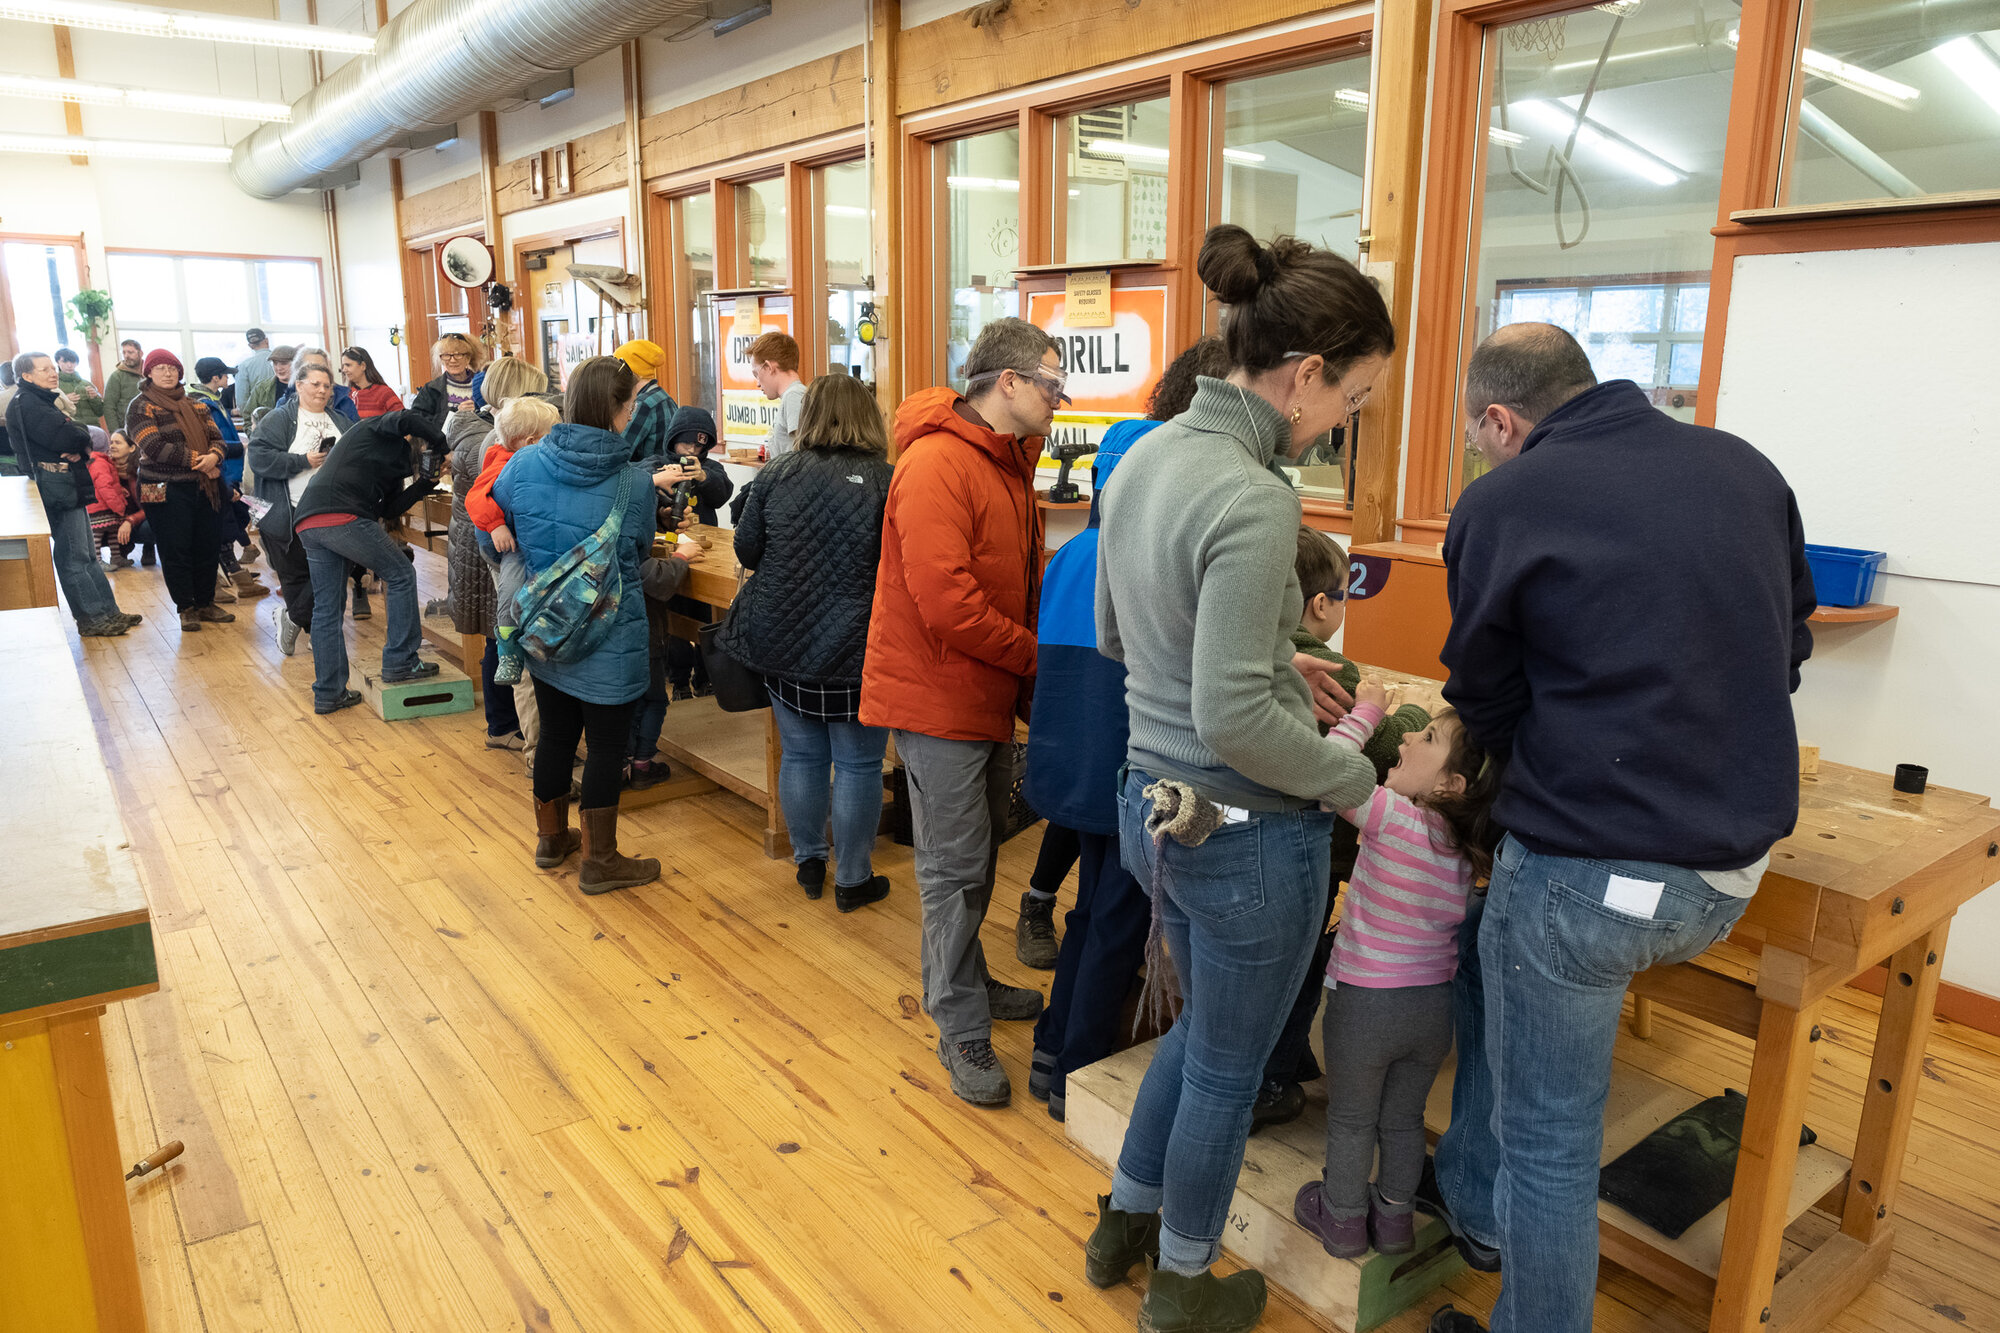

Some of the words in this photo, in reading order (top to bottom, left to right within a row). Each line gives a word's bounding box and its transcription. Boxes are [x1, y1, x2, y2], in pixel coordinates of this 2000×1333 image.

[1056, 333, 1130, 374] DRILL
[726, 404, 757, 425] JUMBO
[1349, 562, 1367, 595] 2
